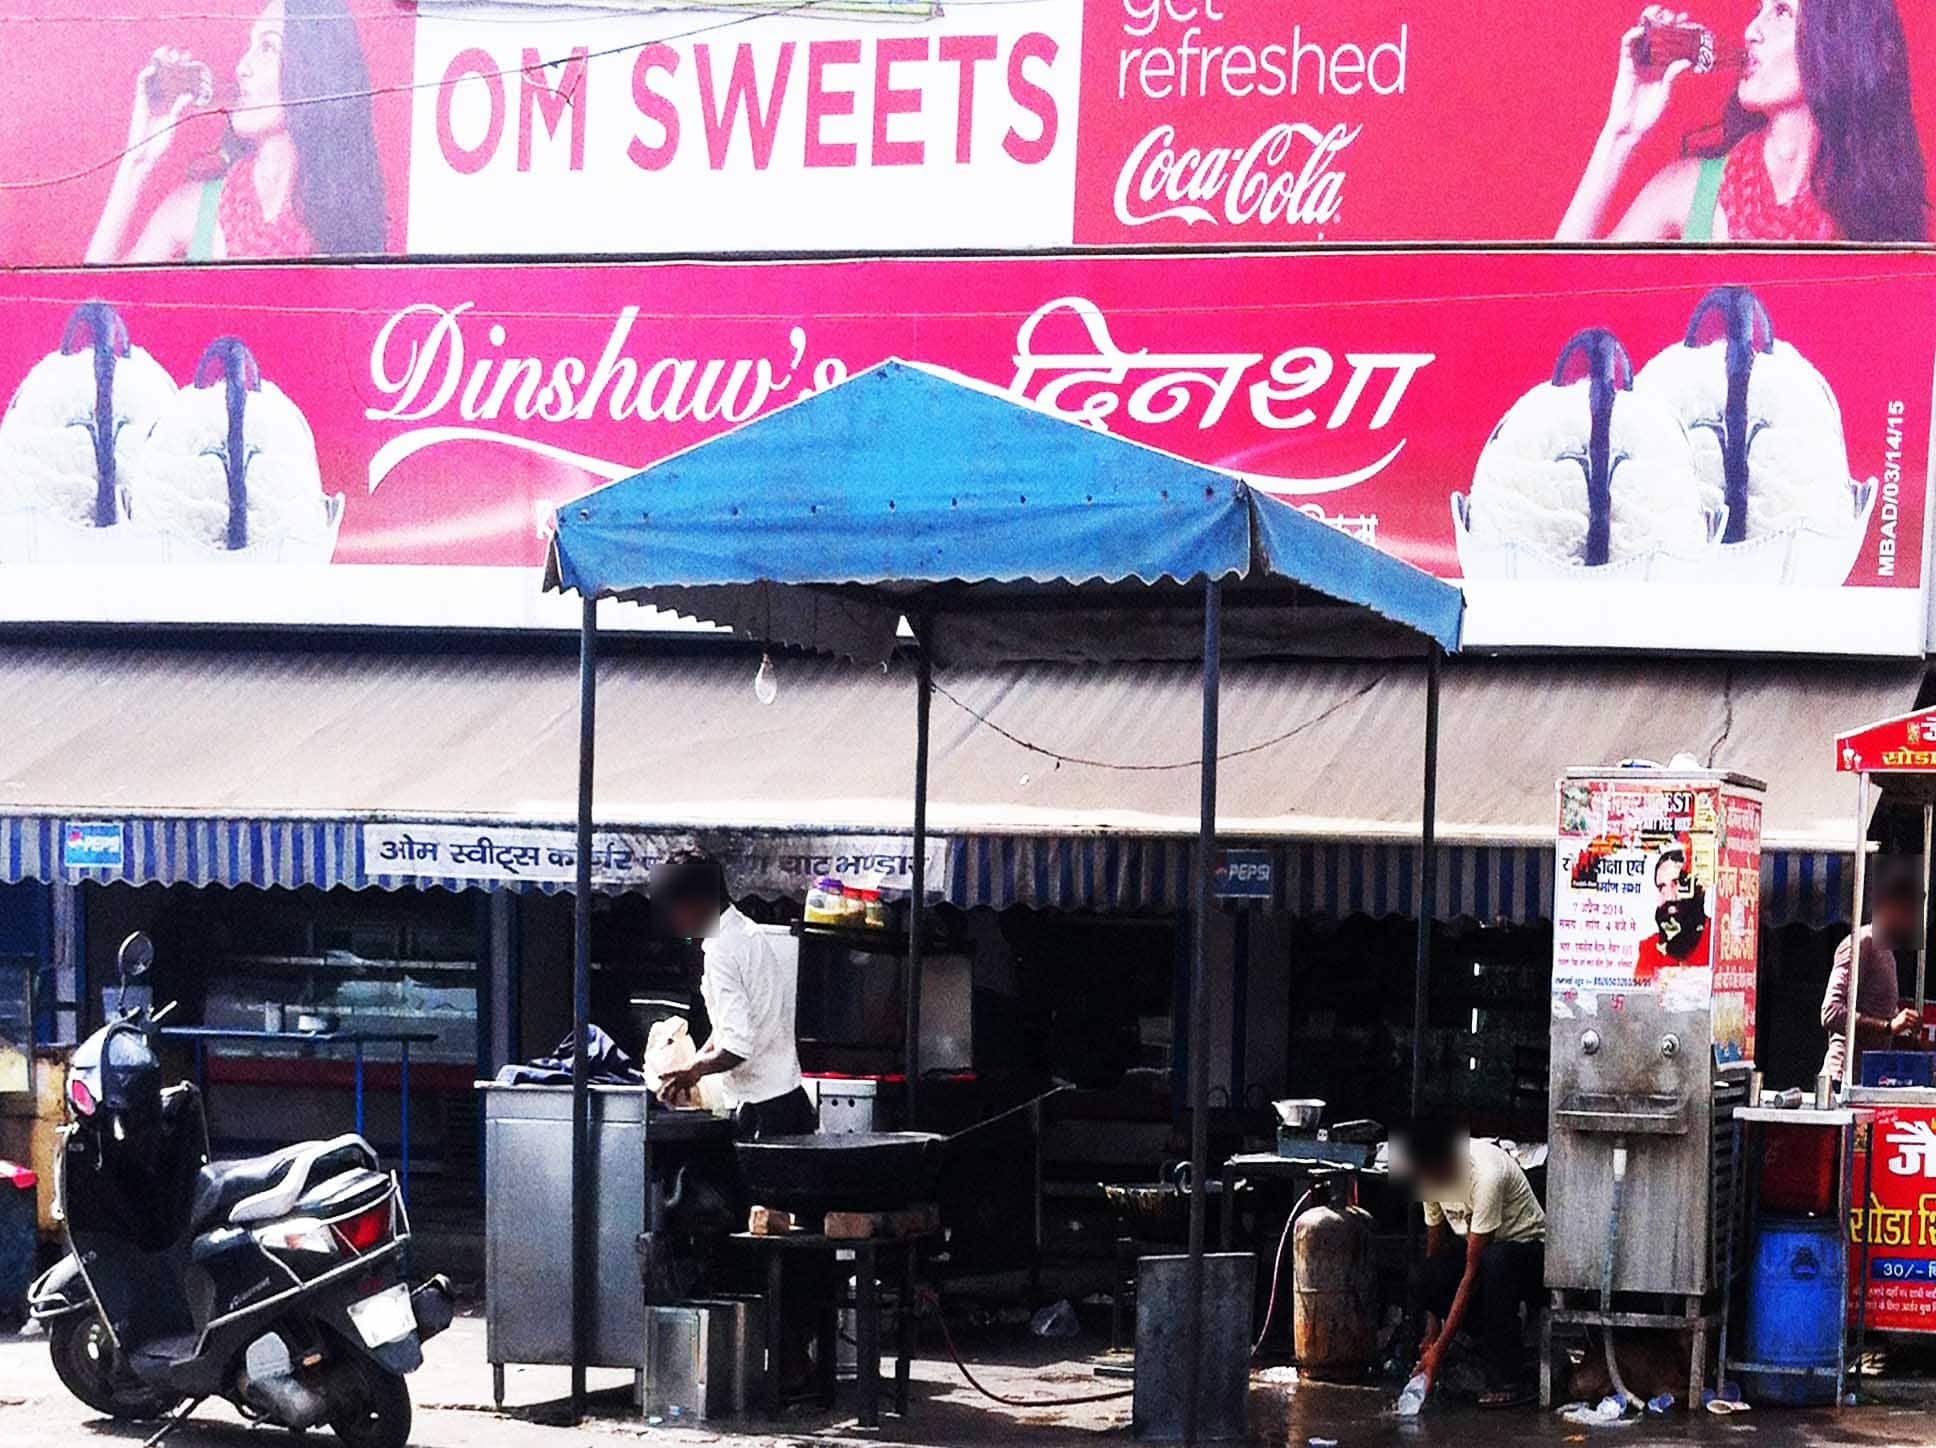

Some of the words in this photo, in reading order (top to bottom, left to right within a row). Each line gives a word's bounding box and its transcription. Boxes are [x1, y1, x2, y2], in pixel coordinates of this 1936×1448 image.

[1119, 24, 1407, 98] refreshed
[435, 47, 588, 175] OM
[626, 32, 1060, 171] SWEETS
[1113, 123, 1363, 226] Coca-Cola
[1012, 297, 1437, 431] दिनशा
[1878, 400, 1905, 577] MBAD/03/14/15
[380, 834, 438, 861] ओम
[1229, 864, 1270, 880] PEPSI
[1602, 904, 1624, 915] 2014
[1883, 1263, 1924, 1278] 30/-
